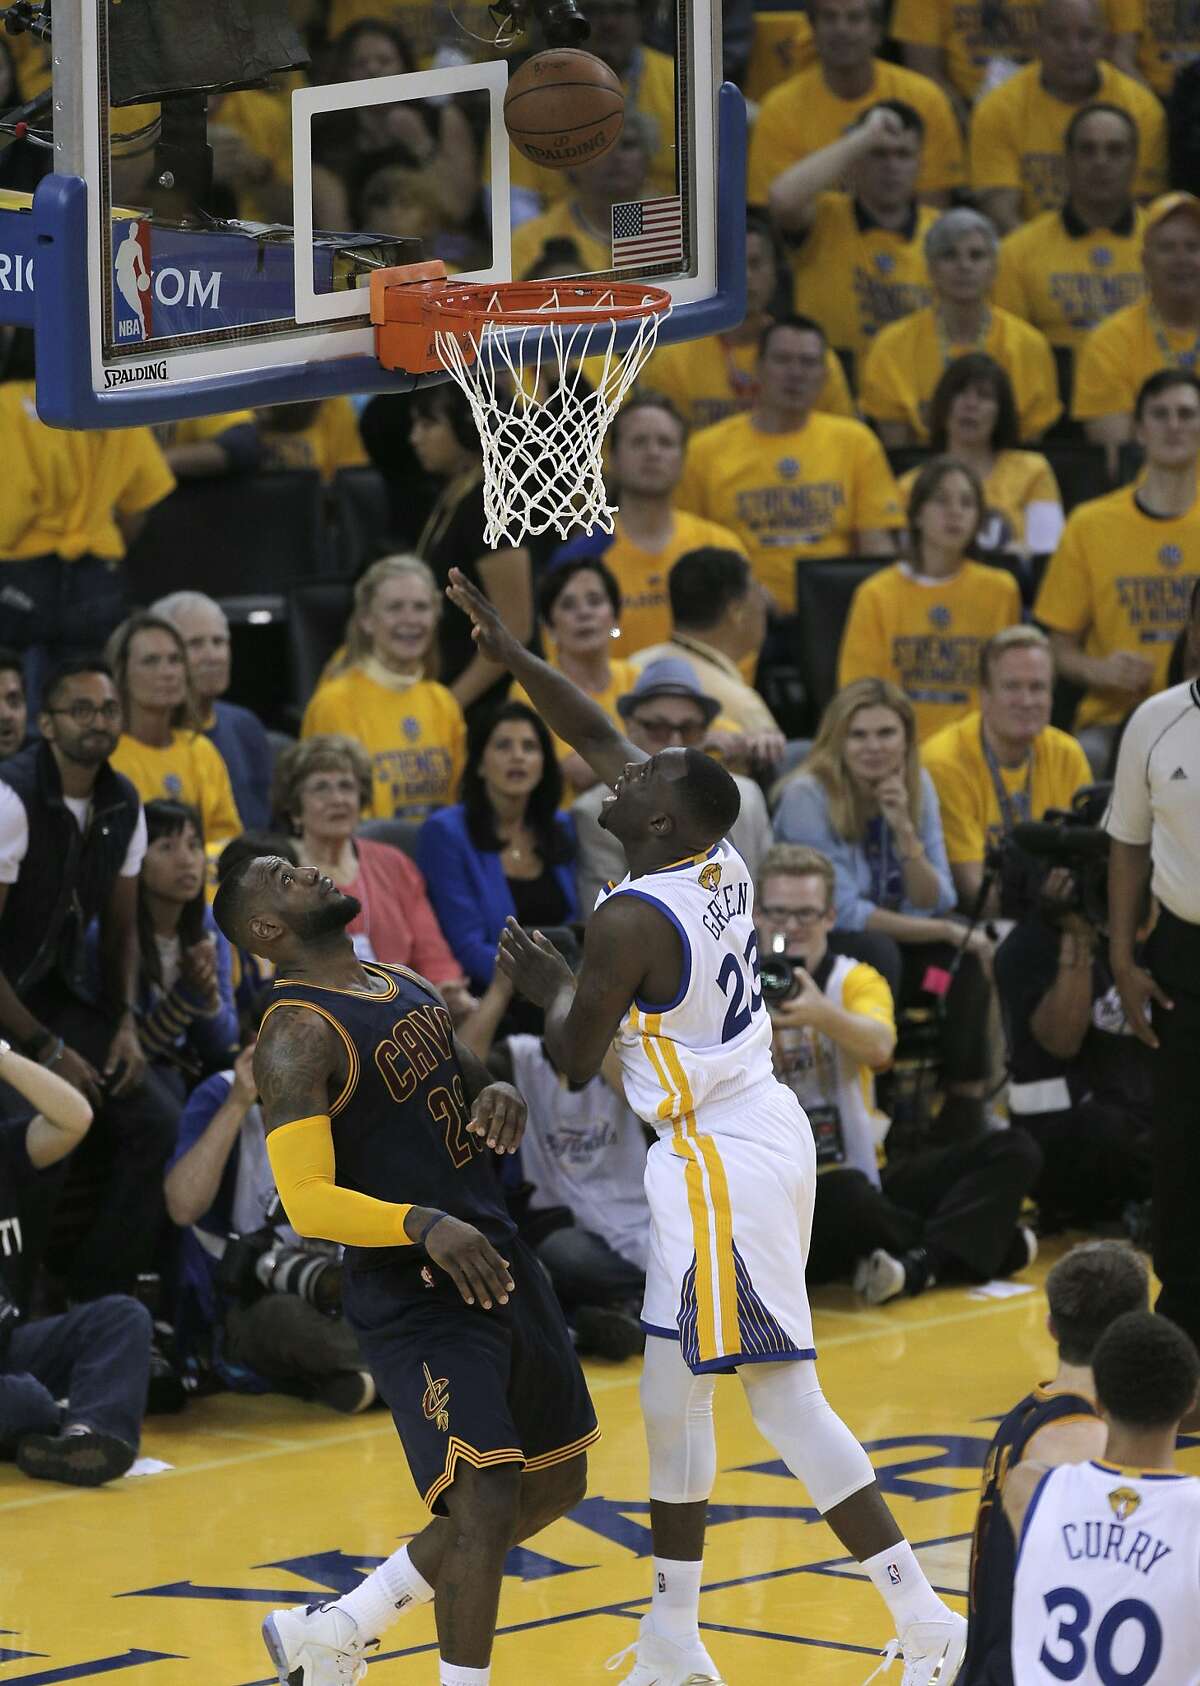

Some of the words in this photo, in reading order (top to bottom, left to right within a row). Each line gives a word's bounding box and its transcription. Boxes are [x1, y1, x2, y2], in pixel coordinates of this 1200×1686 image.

[151, 267, 222, 309] OM
[119, 319, 142, 337] NBA
[104, 361, 168, 389] SPALDING
[1062, 1521, 1173, 1576] CURRY
[1039, 1586, 1164, 1686] 30
